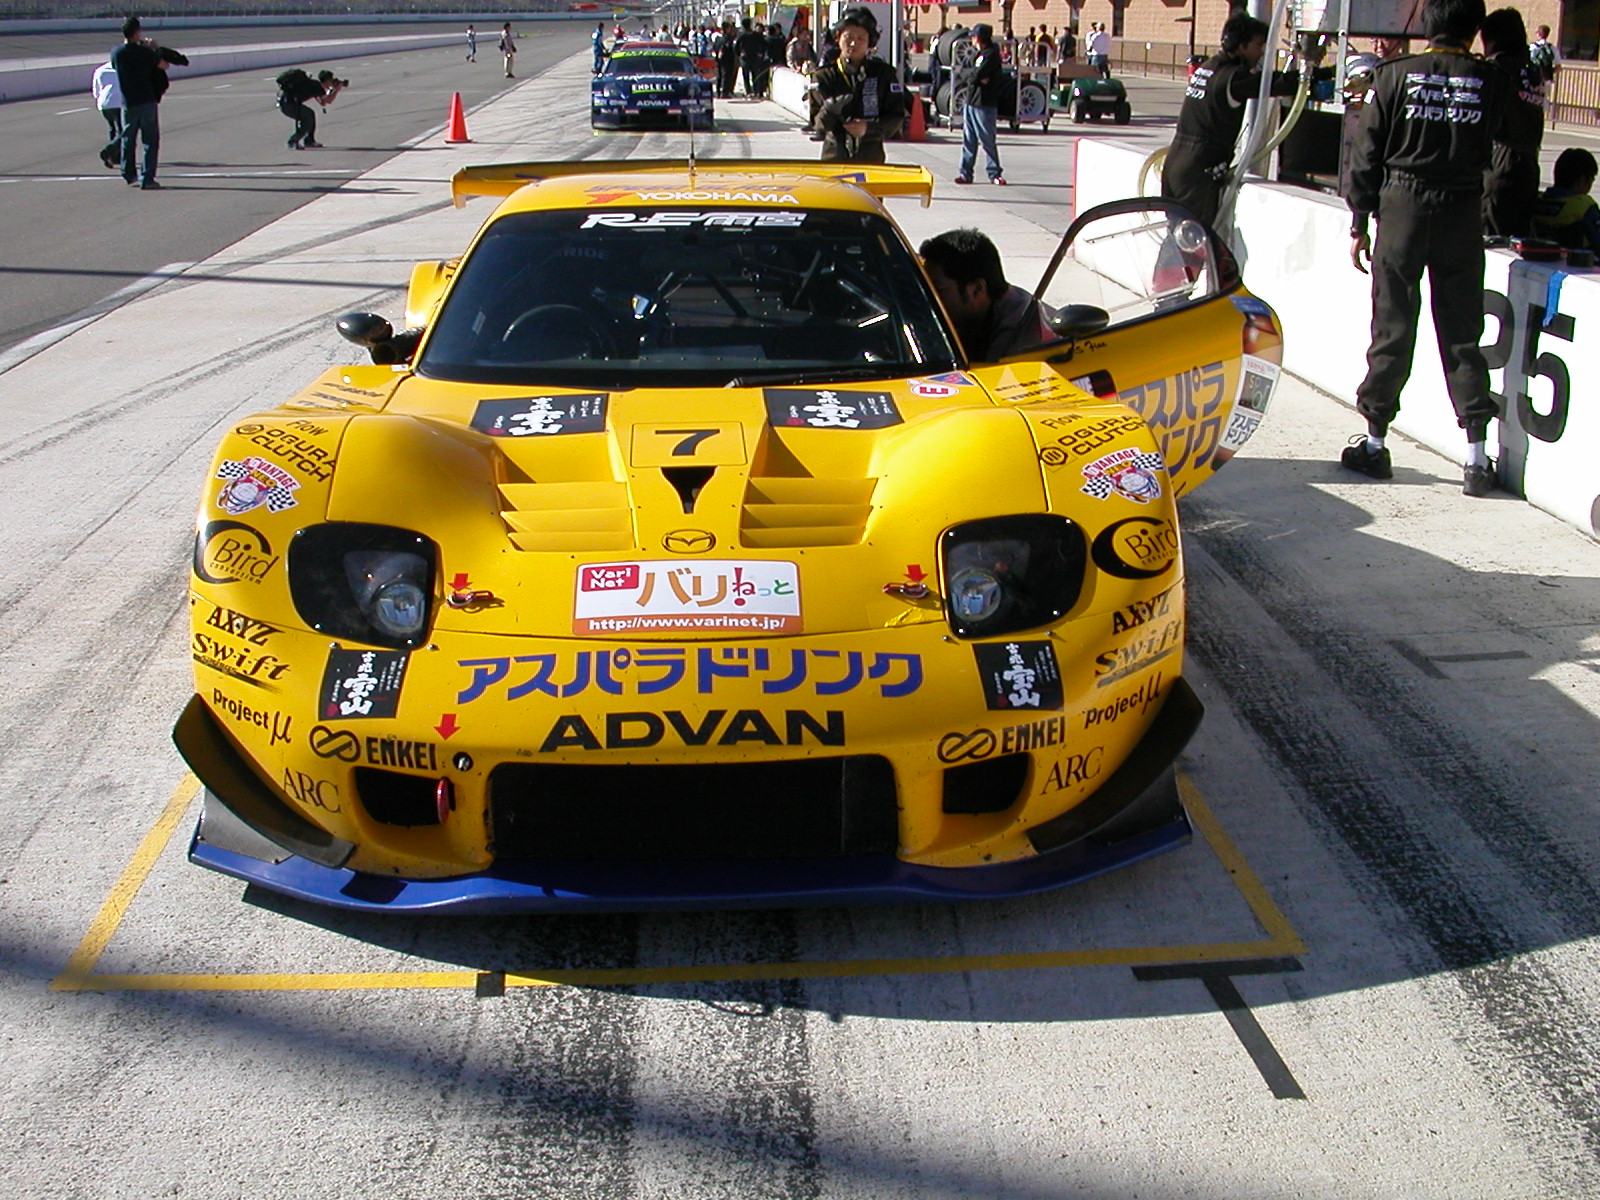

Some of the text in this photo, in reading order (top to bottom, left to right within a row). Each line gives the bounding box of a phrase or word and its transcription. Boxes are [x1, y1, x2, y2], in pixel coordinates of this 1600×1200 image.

[636, 191, 800, 205] YOKOHAMA
[265, 428, 337, 469] OGURA
[654, 429, 721, 457] 7
[1058, 416, 1140, 446] OGURA
[1072, 419, 1147, 456] CLUTCH
[243, 457, 298, 489] ADVANTAGE
[251, 434, 331, 483] CLUTCH
[1083, 449, 1138, 479] ADVANTAGE
[1124, 518, 1178, 559] Bird
[214, 538, 279, 579] Bird
[590, 567, 631, 579] Vari
[590, 577, 625, 588] Net
[206, 606, 285, 646] AXYZ
[589, 616, 787, 632] http://www.varinet.jp/
[1112, 589, 1173, 635] AXYZ
[457, 647, 923, 704] アスパラドリンク
[538, 709, 845, 752] ADVAN
[1001, 716, 1066, 754] ENKEI
[365, 735, 438, 771] ENKEI
[1040, 746, 1105, 796] ARC
[283, 767, 342, 813] ARC
